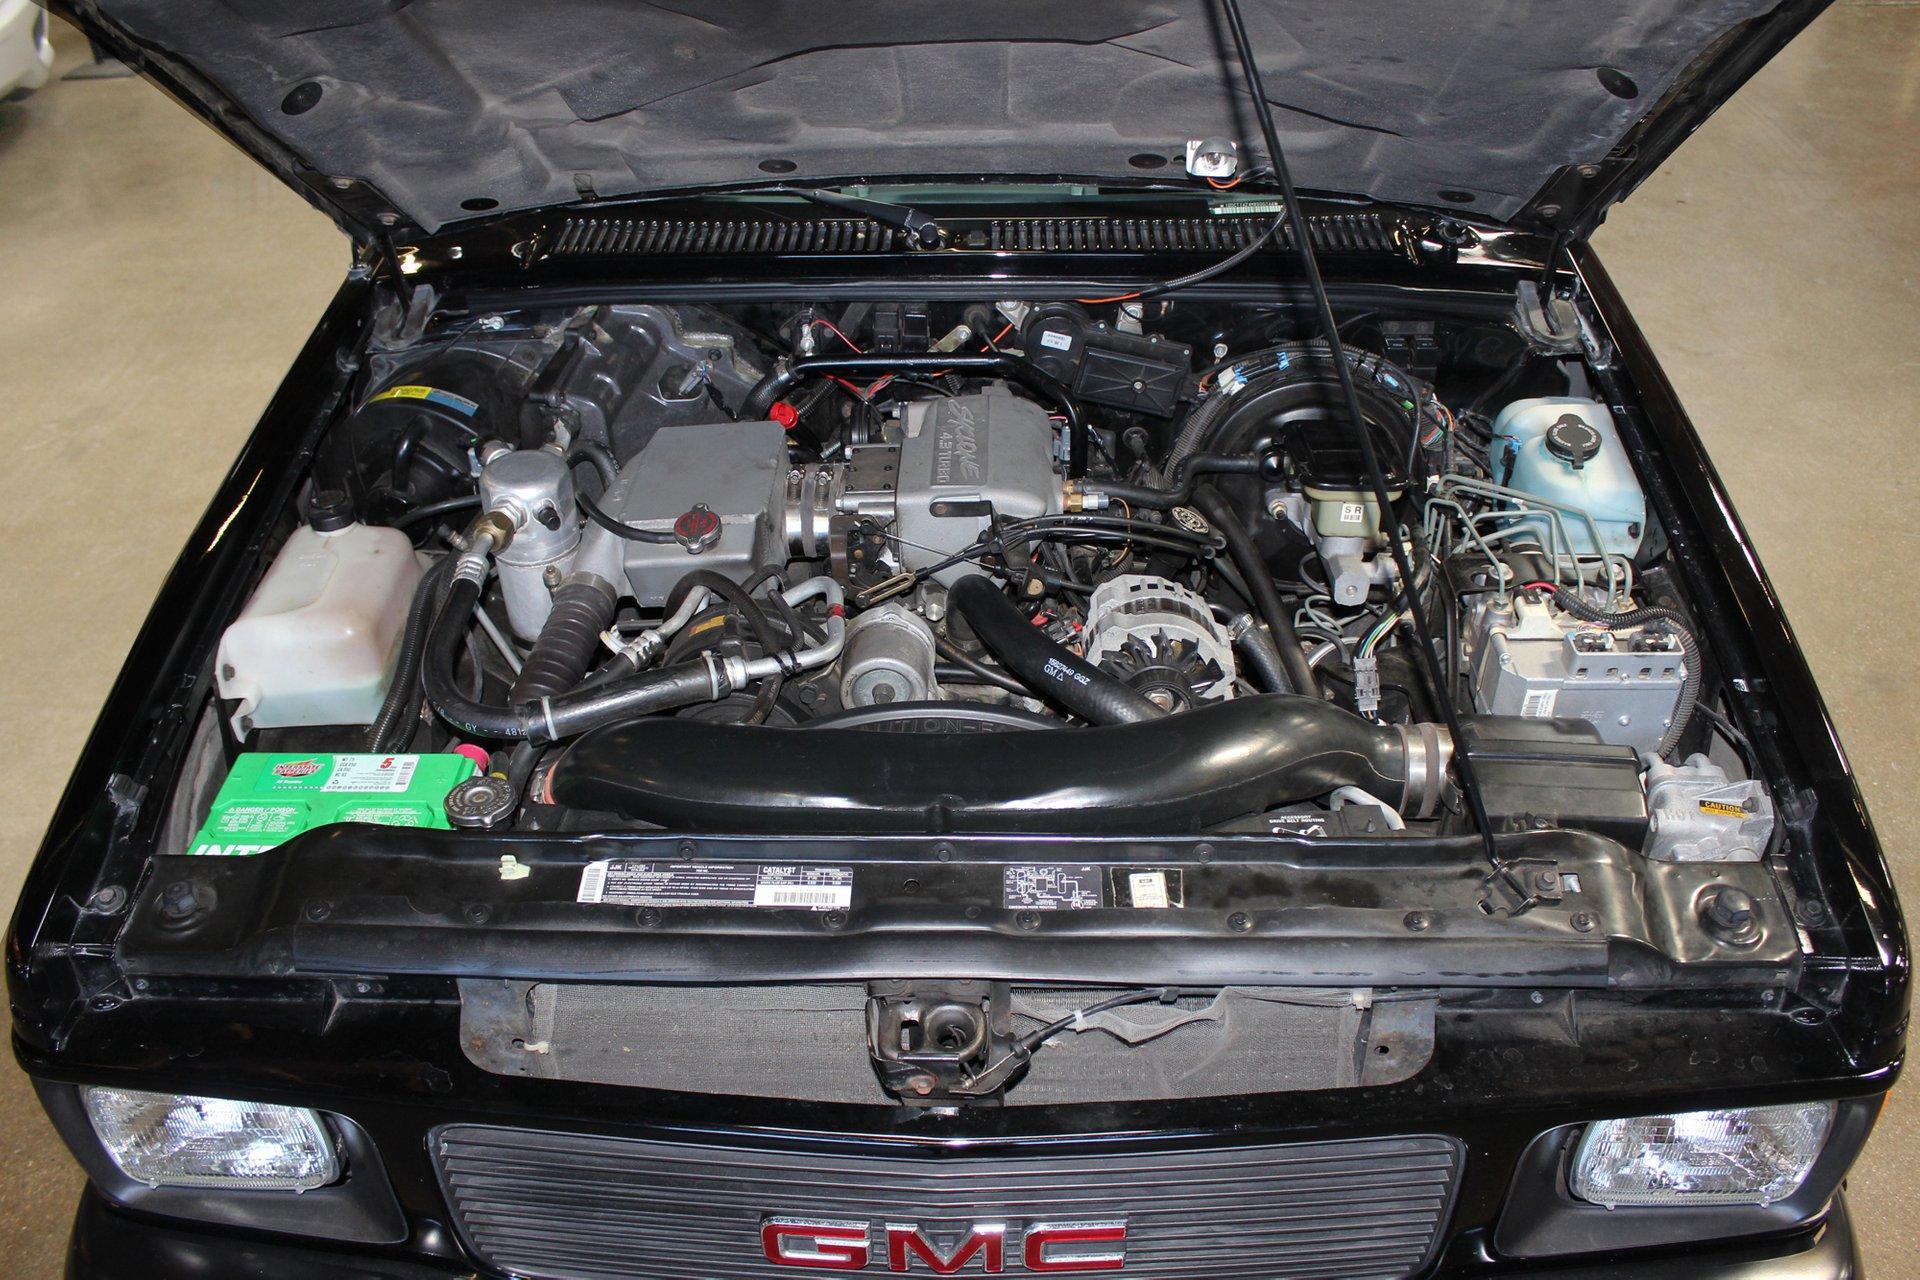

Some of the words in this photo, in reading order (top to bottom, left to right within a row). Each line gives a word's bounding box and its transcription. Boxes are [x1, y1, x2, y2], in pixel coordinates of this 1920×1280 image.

[1043, 664, 1059, 677] GM
[465, 723, 477, 732] GY
[379, 757, 395, 769] 5
[1704, 801, 1741, 812] CAUTION
[763, 866, 796, 874] CATALYST
[760, 1215, 1128, 1274] GMC
